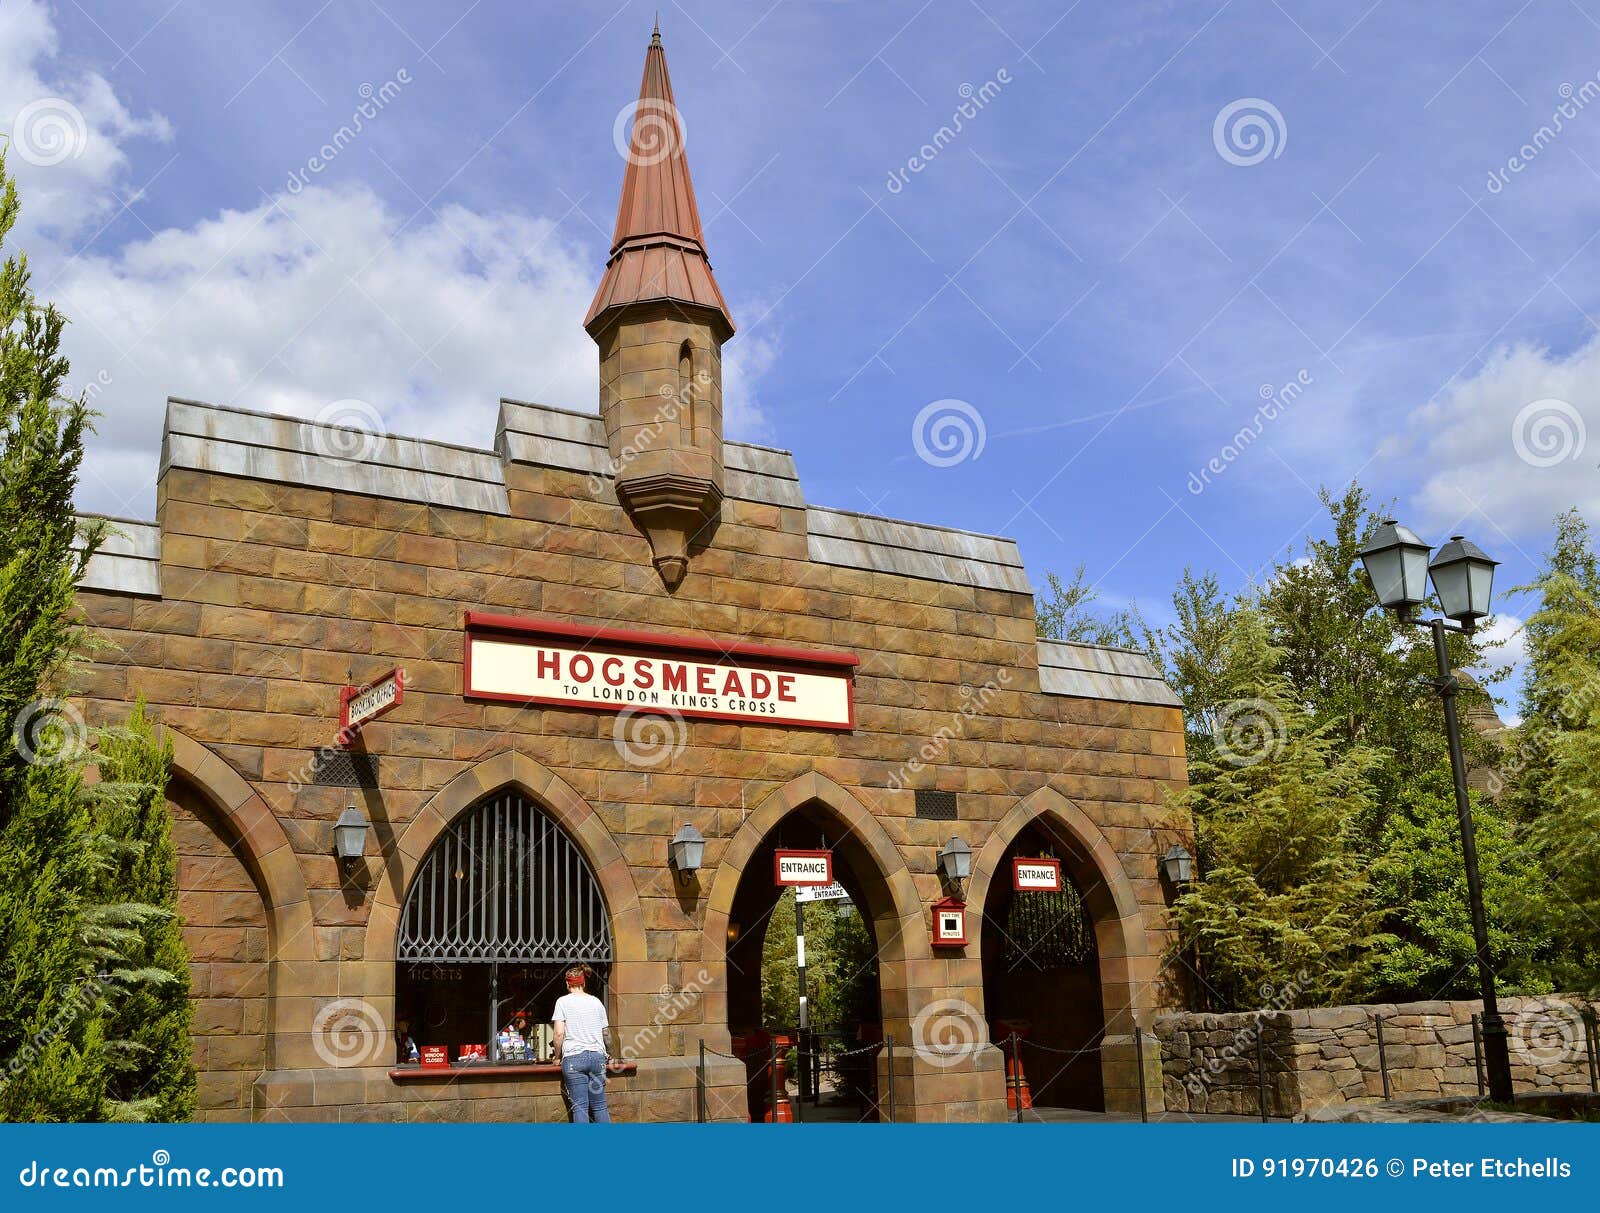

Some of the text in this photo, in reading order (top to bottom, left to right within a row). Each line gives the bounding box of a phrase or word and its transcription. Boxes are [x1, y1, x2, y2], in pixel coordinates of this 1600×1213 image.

[537, 650, 797, 702] HOGSMEADE
[351, 683, 396, 719] BOOKING OFFICE
[563, 685, 776, 713] TO LONDON KING'S CROSS
[780, 862, 826, 873] ENTRANCE
[1018, 869, 1055, 880] ENTRANCE
[814, 888, 844, 899] ENTRANCE
[410, 968, 464, 981] TICKETS
